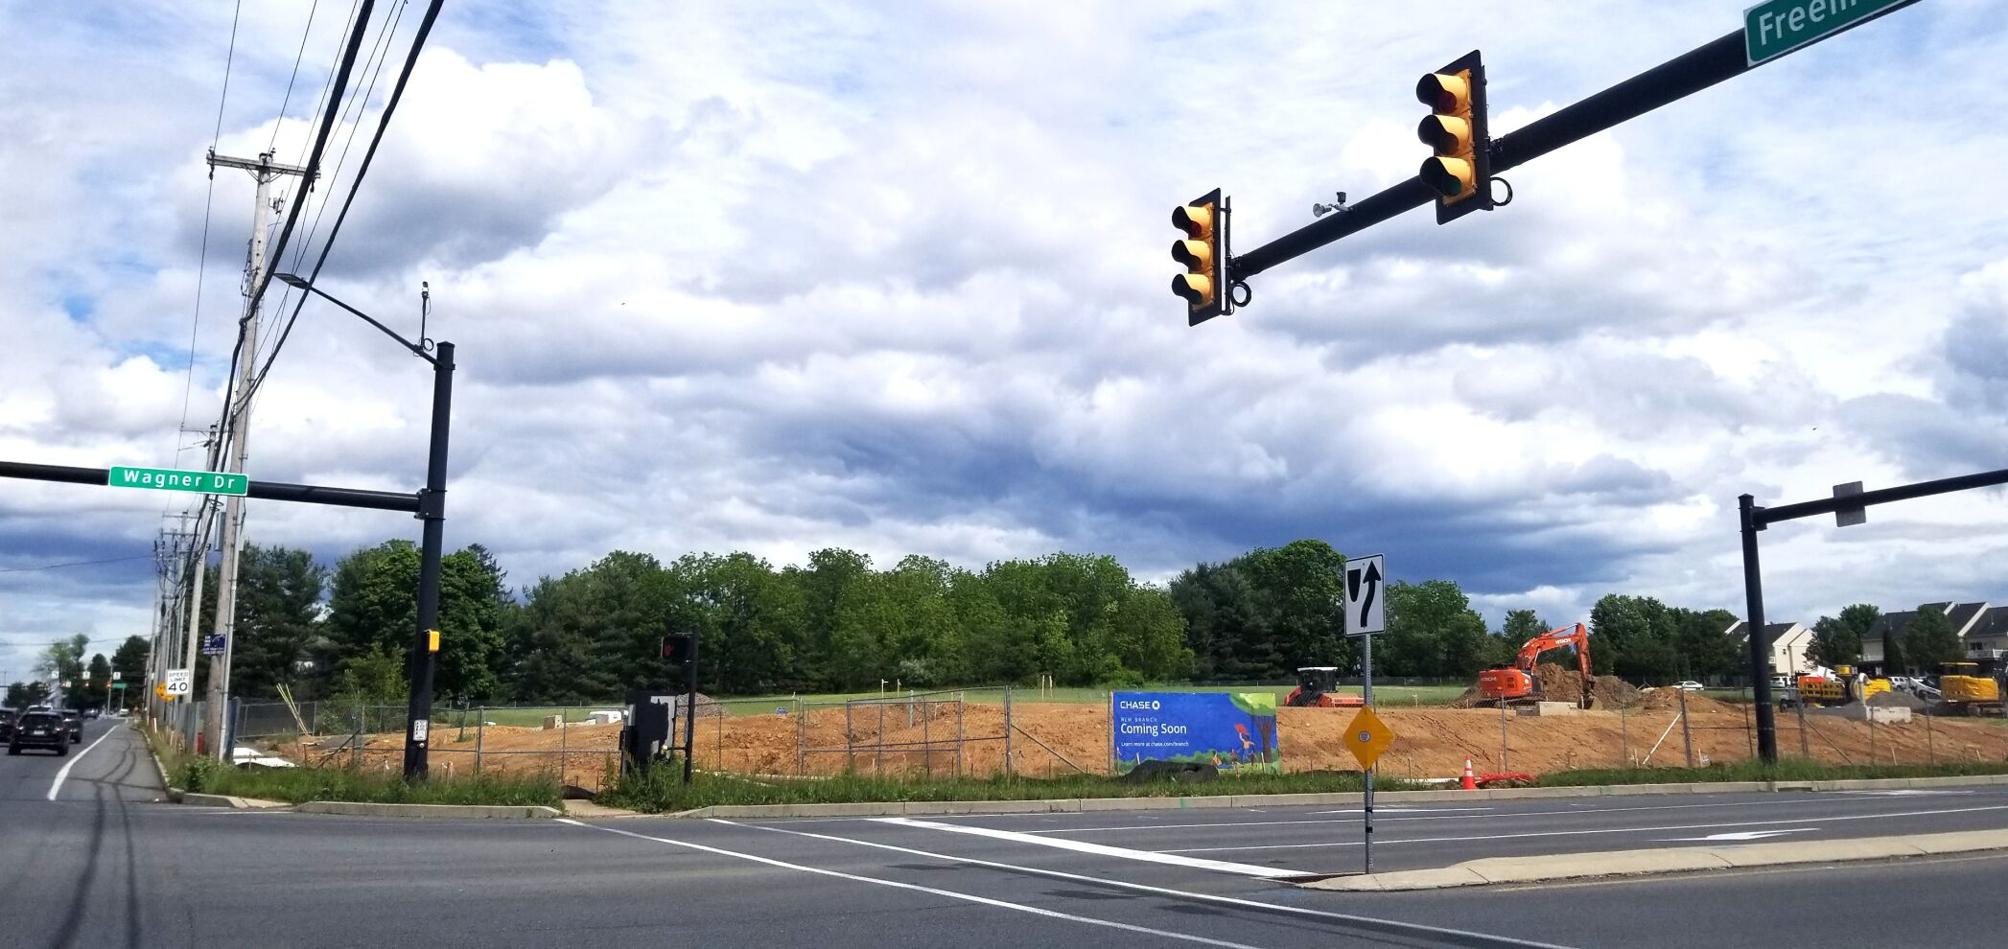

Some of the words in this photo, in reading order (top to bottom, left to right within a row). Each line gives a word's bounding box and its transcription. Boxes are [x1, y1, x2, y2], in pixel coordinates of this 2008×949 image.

[124, 469, 202, 488] Wagner
[214, 475, 235, 489] Dr
[168, 682, 188, 692] 40
[1120, 701, 1151, 710] CHASE
[1120, 723, 1159, 737] Coming
[1161, 723, 1187, 735] Soon
